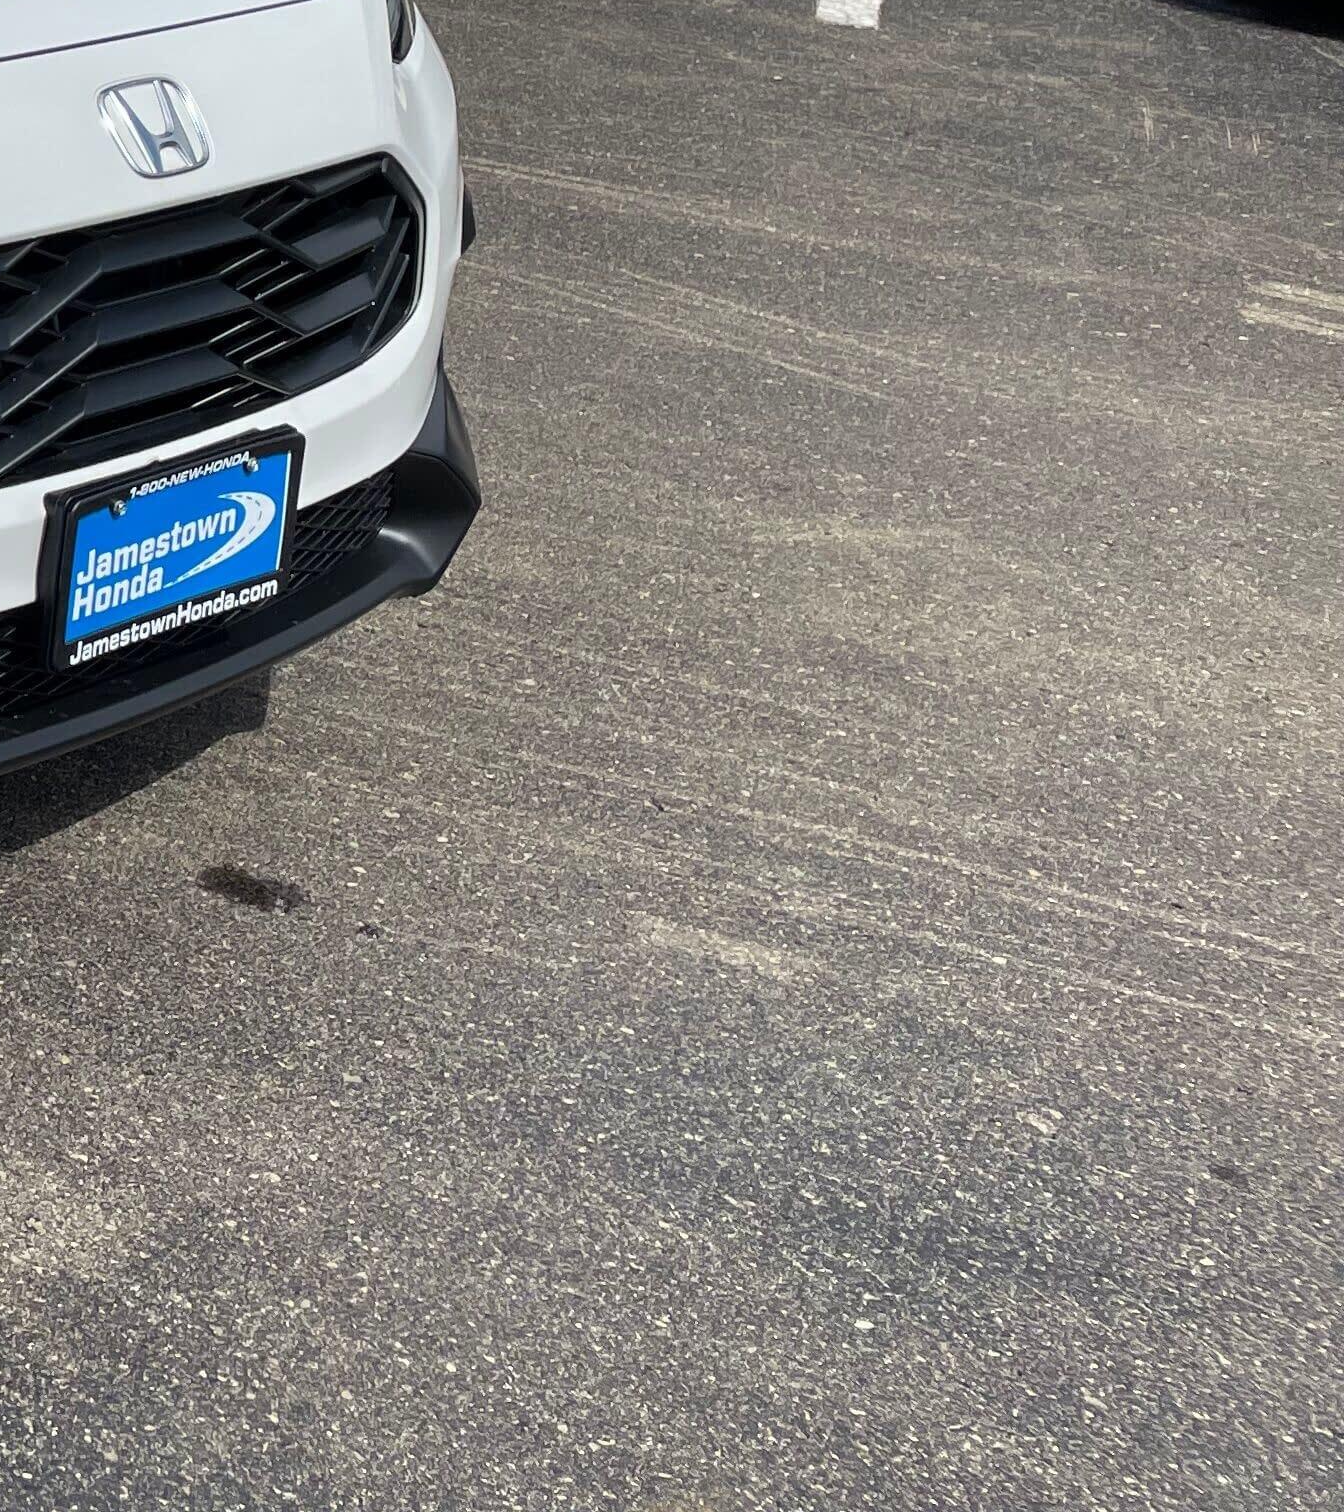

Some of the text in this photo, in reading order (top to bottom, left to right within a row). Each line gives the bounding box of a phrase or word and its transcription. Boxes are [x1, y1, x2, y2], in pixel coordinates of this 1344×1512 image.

[129, 450, 252, 500] 1-800-NEW-HONDA
[76, 507, 237, 585] Jamestown
[69, 578, 279, 667] JamestownHonda.com
[71, 563, 164, 622] Honda
